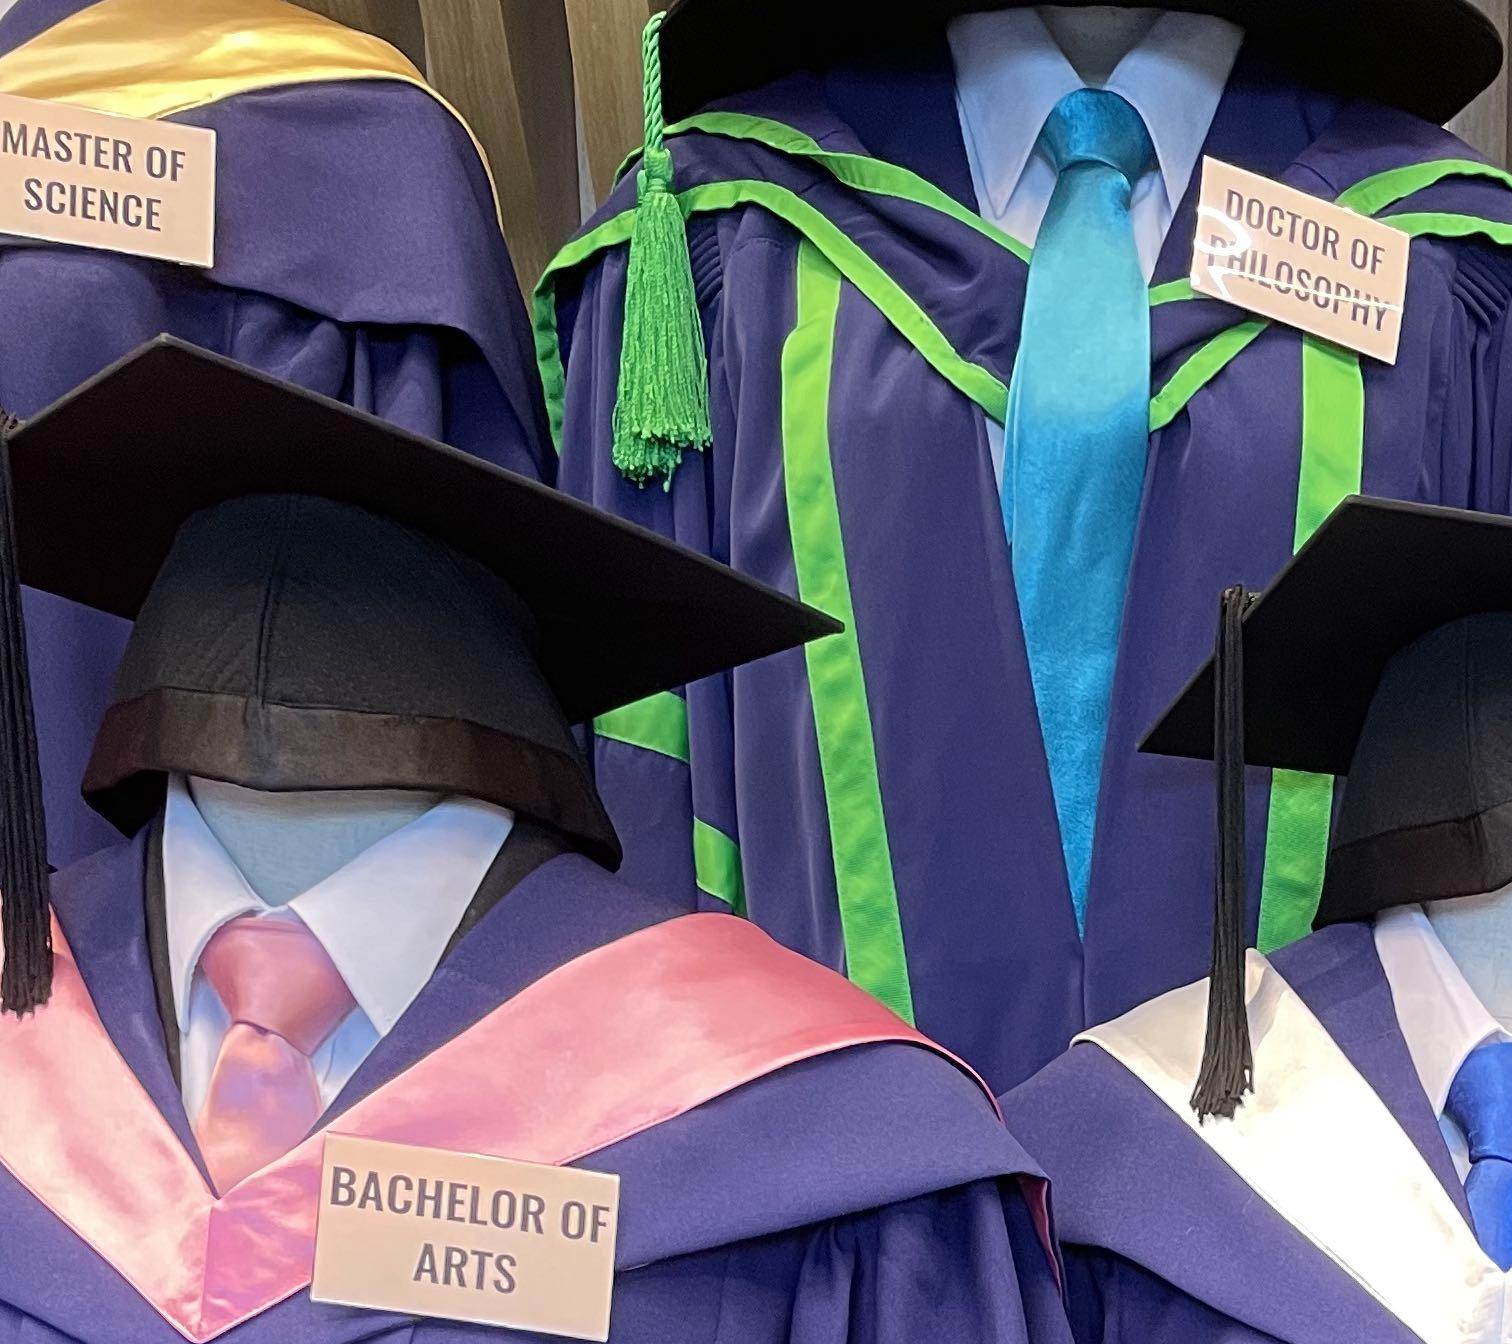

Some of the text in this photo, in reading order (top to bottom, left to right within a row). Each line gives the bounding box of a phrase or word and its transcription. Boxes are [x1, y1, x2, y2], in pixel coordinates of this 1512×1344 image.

[2, 120, 186, 182] MASTER OF
[24, 178, 162, 232] SCIENCE
[1225, 189, 1386, 275] DOCTOR OF
[330, 1166, 610, 1243] BACHELOR OF
[413, 1243, 517, 1294] ARTS
